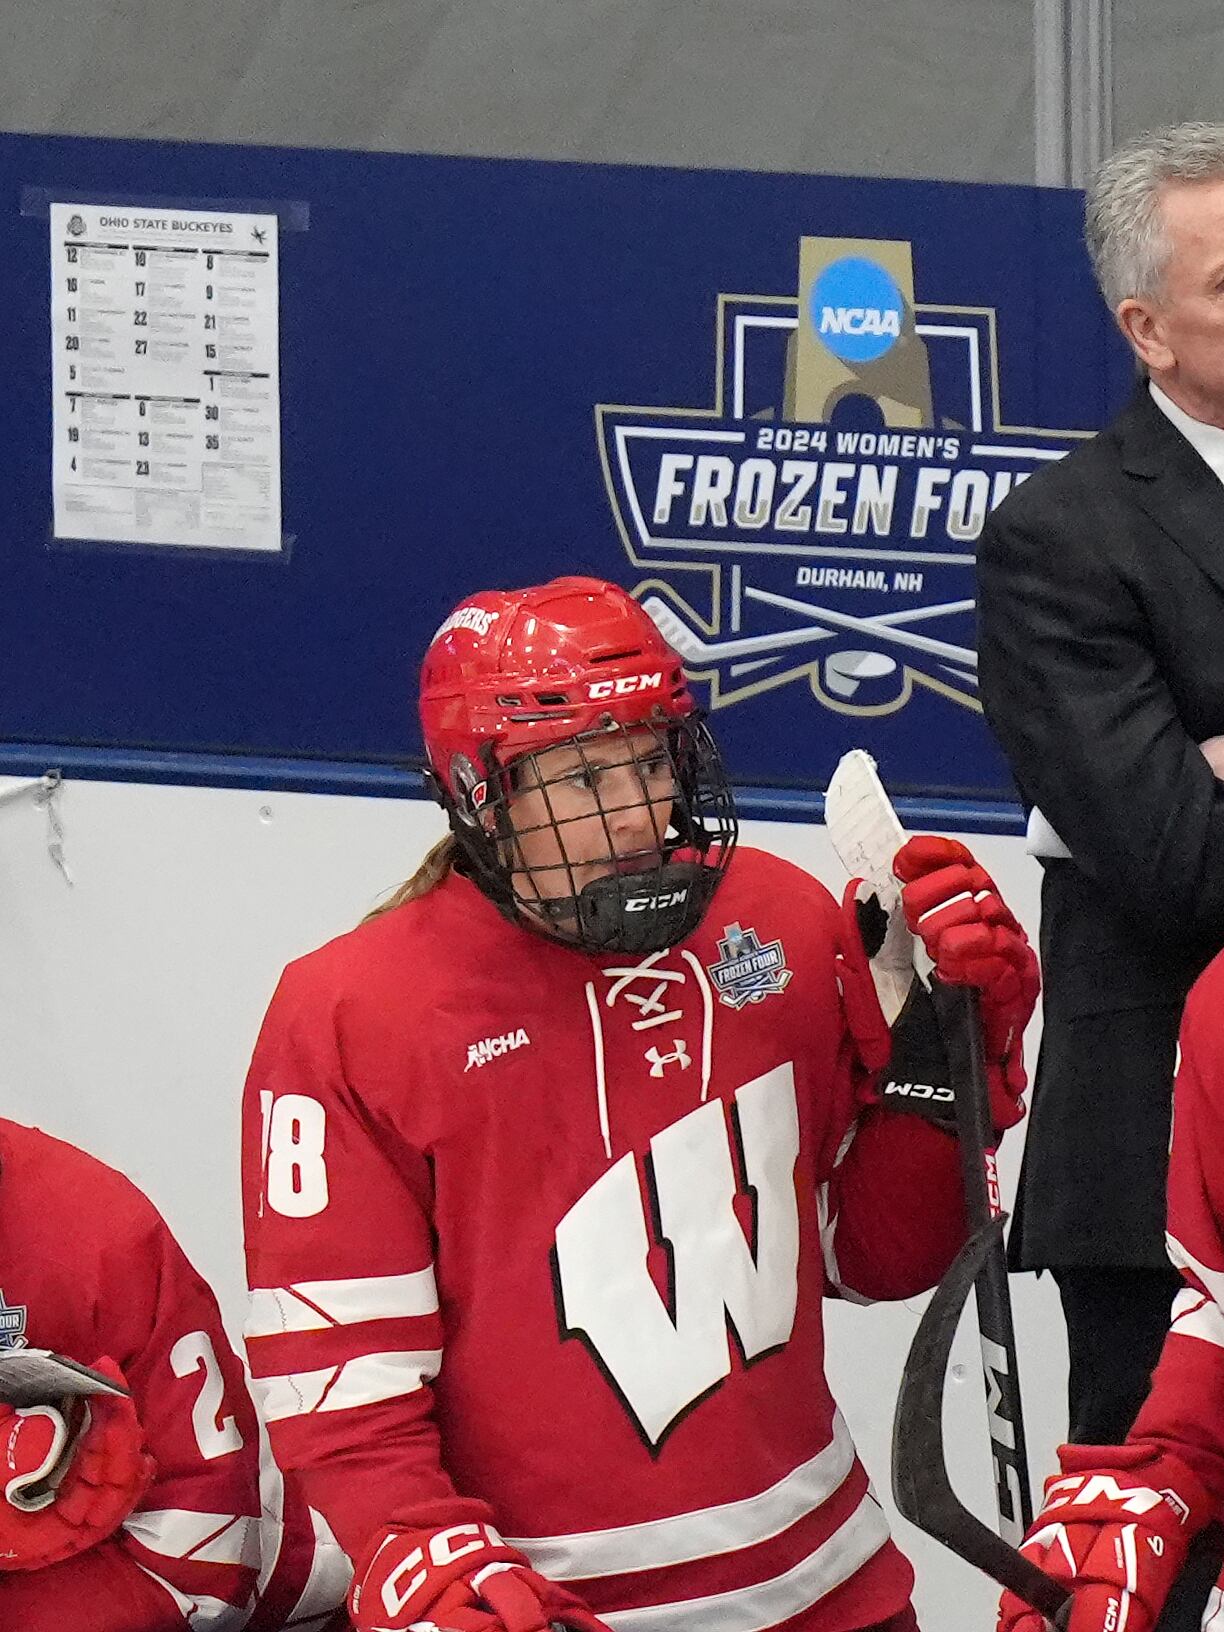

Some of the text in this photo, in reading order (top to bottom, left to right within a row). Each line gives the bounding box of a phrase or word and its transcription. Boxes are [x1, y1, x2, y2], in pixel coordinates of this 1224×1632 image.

[100, 216, 233, 233] OHIO STATE BUCKEYES
[67, 248, 78, 263] 12
[135, 281, 145, 296] 17
[67, 307, 76, 321] 11
[204, 314, 216, 329] 21
[820, 305, 900, 337] NCAA
[135, 339, 147, 354] 27
[205, 344, 216, 358] 15
[757, 428, 960, 459] 2024 WOMEN'S
[653, 453, 898, 536] FROZEN
[797, 566, 924, 592] DURHAM, NH
[588, 672, 662, 699] CCM
[625, 889, 688, 913] CCM
[718, 960, 753, 984] FROZEN
[752, 950, 779, 971] FOUR
[884, 1080, 956, 1102] CCM
[549, 1061, 800, 1462] W
[169, 1331, 244, 1461] 2
